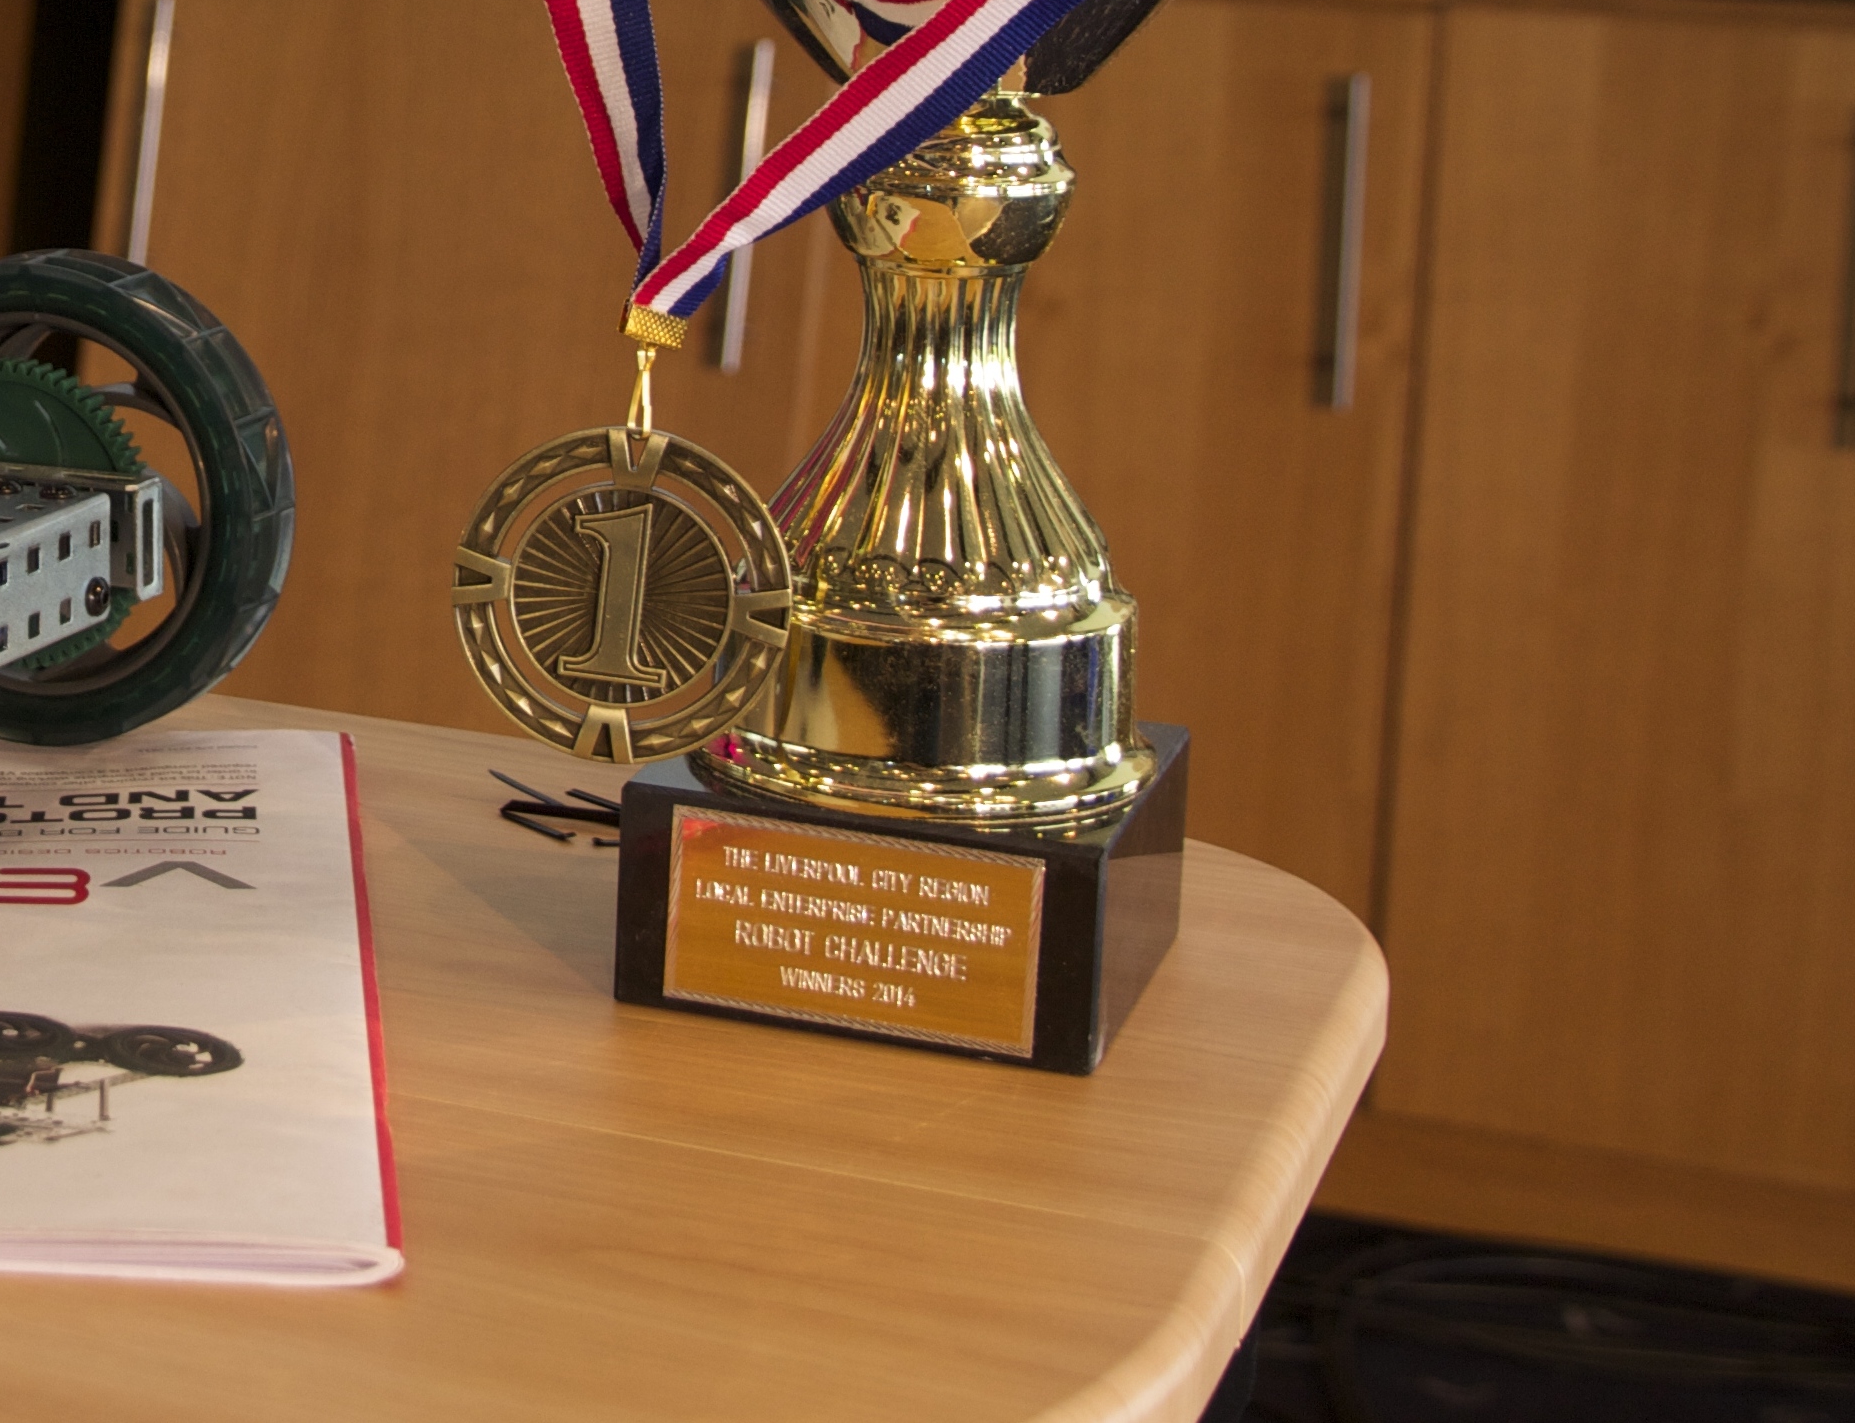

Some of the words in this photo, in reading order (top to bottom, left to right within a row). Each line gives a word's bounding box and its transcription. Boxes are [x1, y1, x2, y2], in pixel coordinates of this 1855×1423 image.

[558, 503, 667, 688] 1
[59, 789, 259, 806] AND
[40, 827, 121, 836] FOR
[137, 826, 260, 835] GUIDE
[723, 846, 758, 872] THE
[765, 852, 863, 887] LIVERPOOL
[871, 870, 913, 892] CITY
[919, 875, 990, 908] REGION
[695, 878, 753, 908] LOCAL
[760, 889, 874, 926] ENTERPRISE
[882, 908, 1013, 948] PARTNERSHIP
[734, 920, 816, 955] ROBOT
[824, 934, 968, 981] CHALLENGE
[780, 966, 865, 999] WINNERS
[871, 982, 916, 1008] 2014
